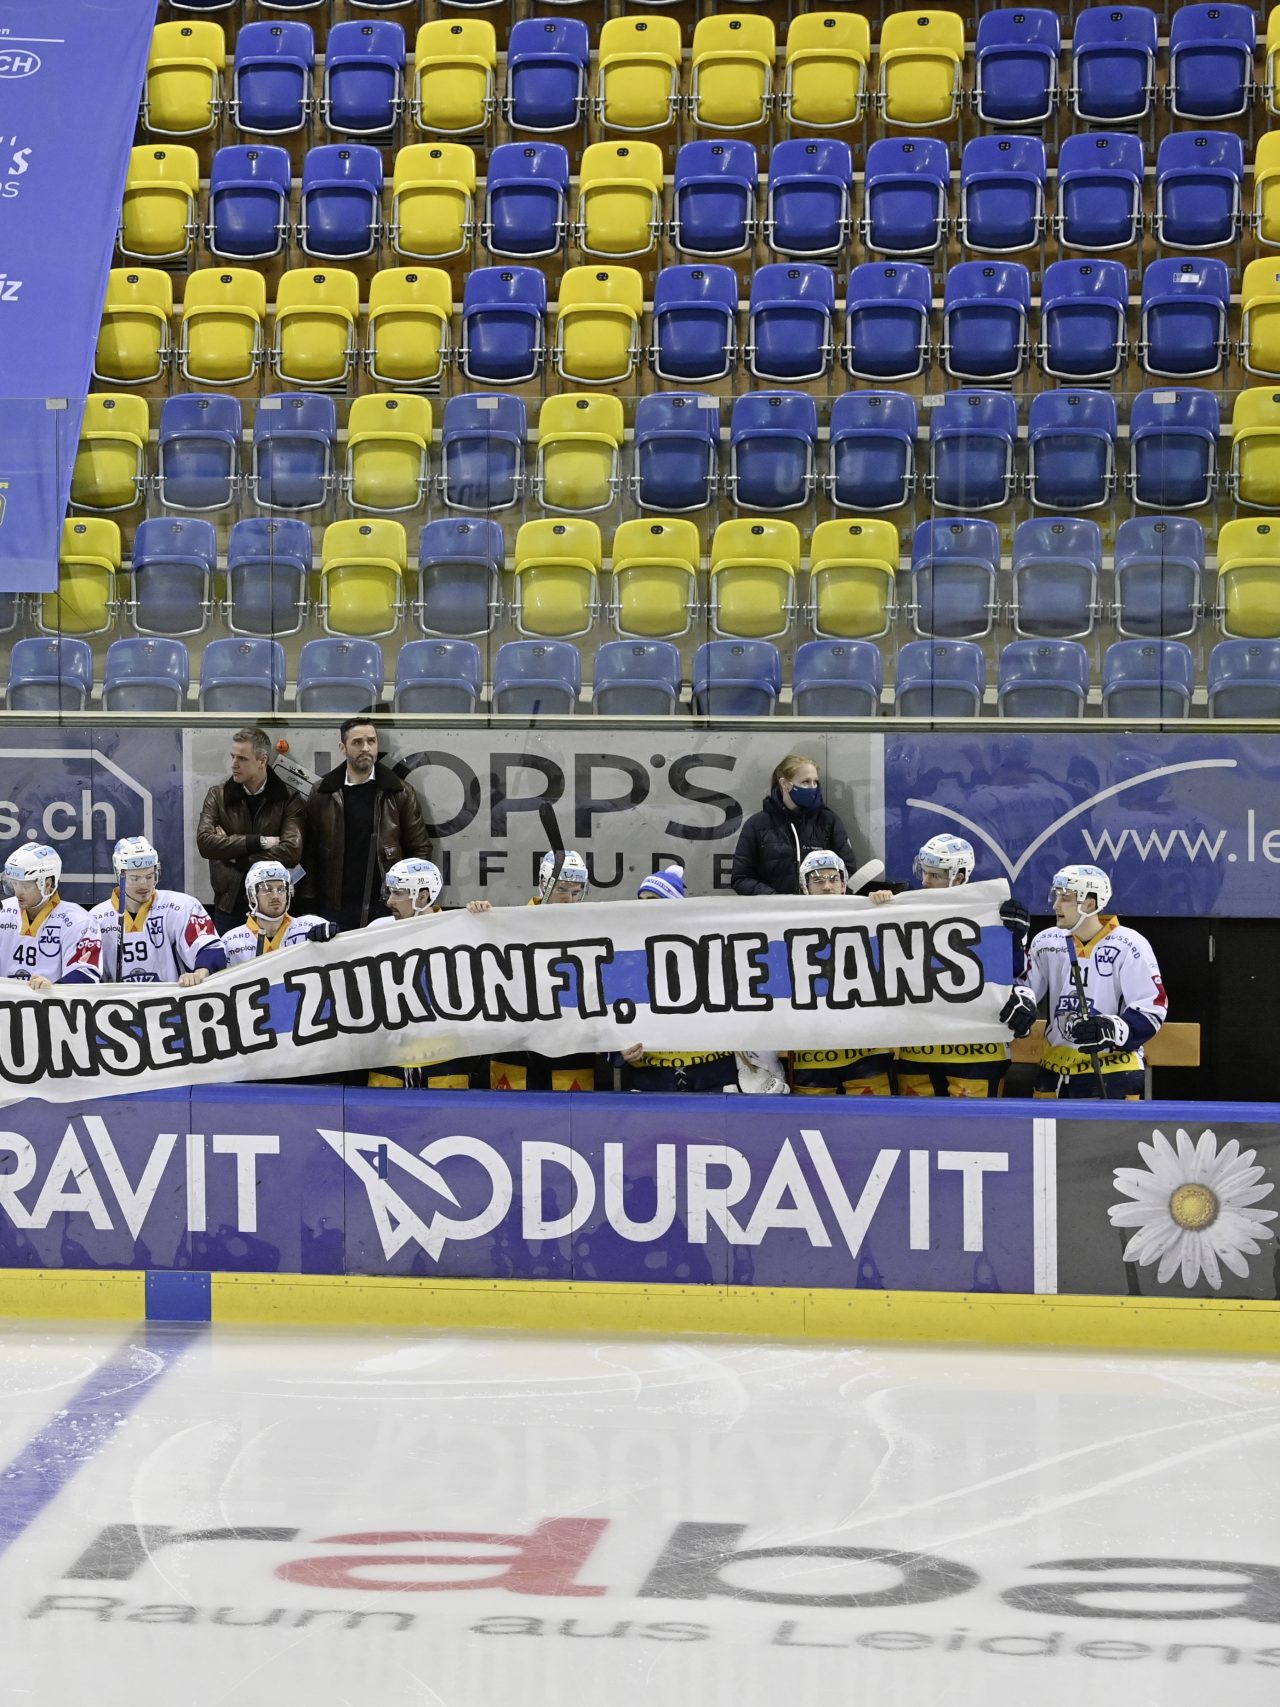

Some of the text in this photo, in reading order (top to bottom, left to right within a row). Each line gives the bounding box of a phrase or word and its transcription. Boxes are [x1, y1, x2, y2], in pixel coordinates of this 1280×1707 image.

[13, 944, 37, 967] 48
[122, 941, 148, 963] 59
[644, 932, 774, 1014] DIE
[784, 916, 985, 1011] FANS
[521, 1129, 1009, 1261] DURAVIT
[25, 1594, 417, 1632] Raum
[470, 1614, 711, 1642] aus
